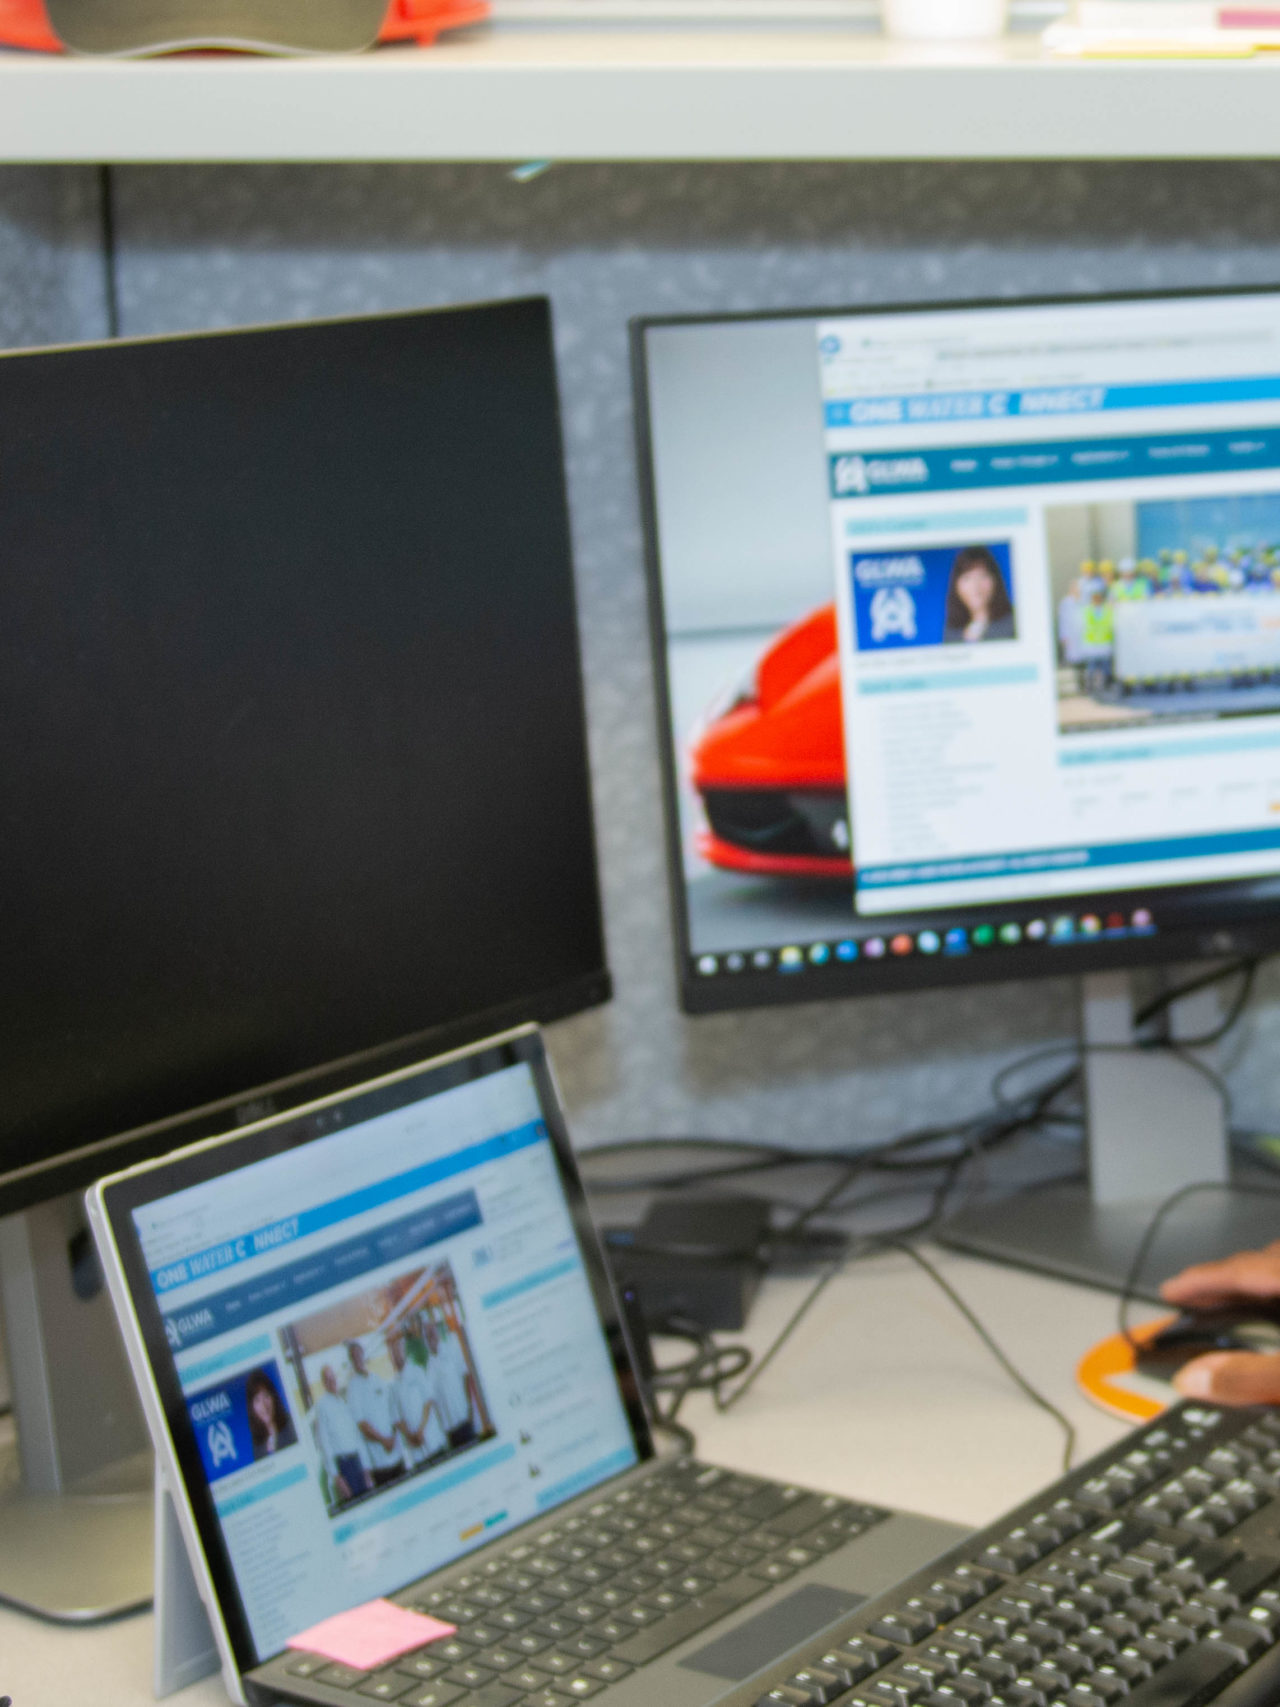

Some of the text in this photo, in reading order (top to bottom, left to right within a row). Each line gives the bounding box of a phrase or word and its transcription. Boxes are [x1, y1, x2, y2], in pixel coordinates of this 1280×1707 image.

[156, 1262, 188, 1288] ONE
[189, 1245, 234, 1276] WATER
[177, 1308, 212, 1334] GLWA
[190, 1392, 231, 1421] GLWA
